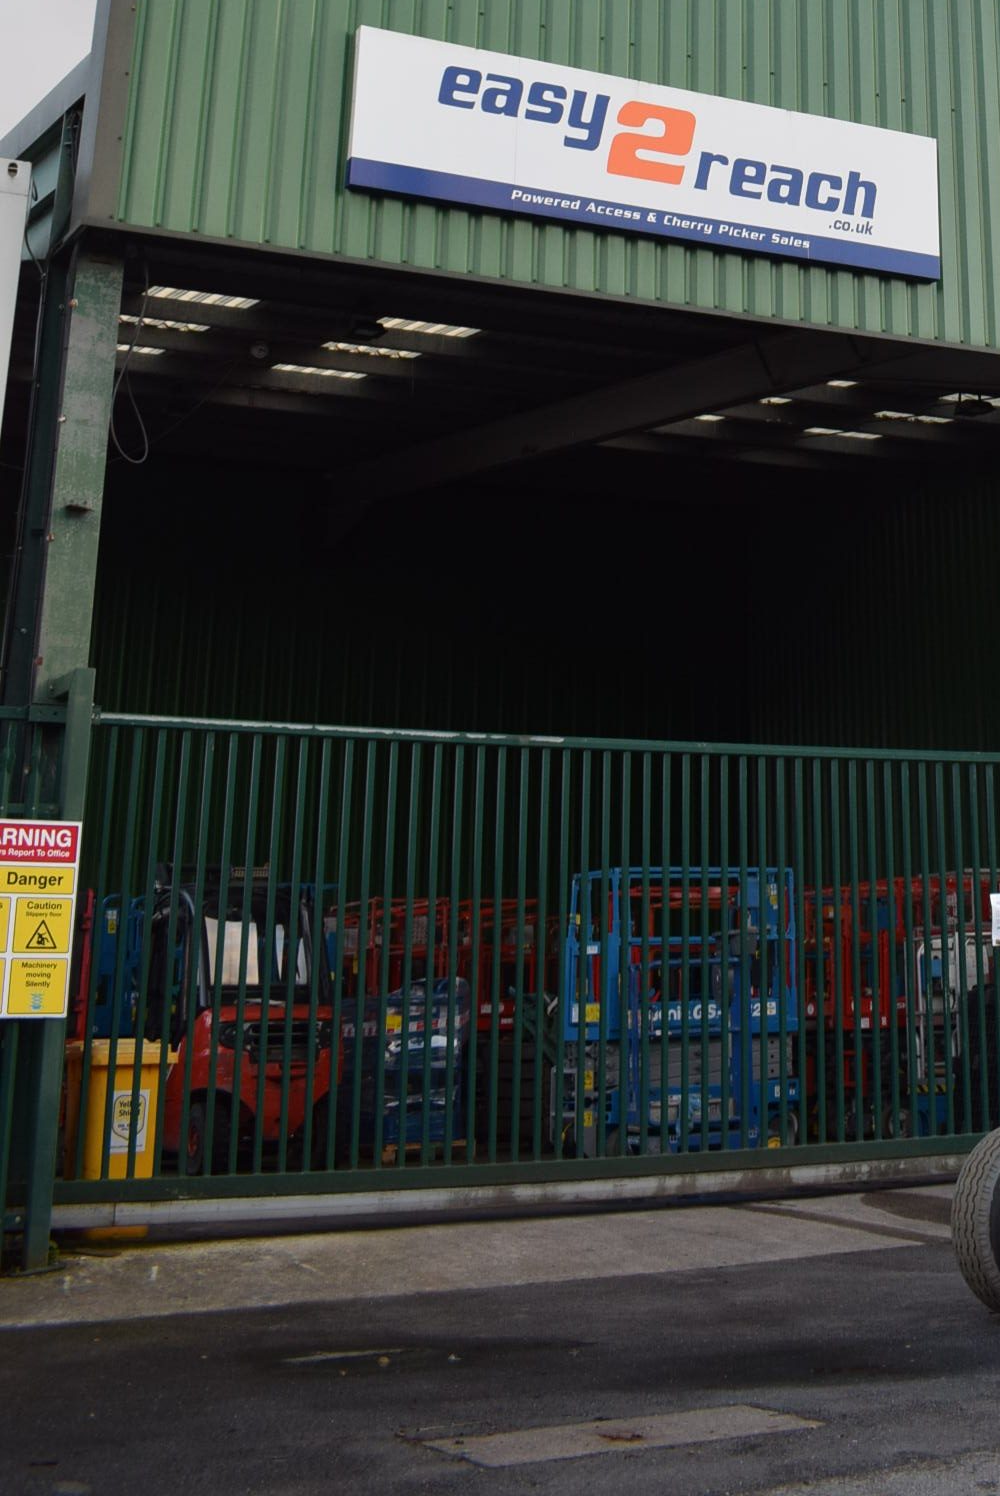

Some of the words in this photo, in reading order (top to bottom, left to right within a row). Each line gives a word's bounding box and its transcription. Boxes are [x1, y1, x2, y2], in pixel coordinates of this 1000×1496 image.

[511, 189, 580, 210] Powered
[585, 202, 641, 221] Access
[647, 213, 657, 224] &
[663, 214, 713, 235] Cherry
[771, 232, 811, 249] Sales
[828, 217, 873, 236] .co.uk
[0, 827, 72, 848] RNING
[8, 848, 35, 857] Report
[36, 849, 46, 857] To
[47, 849, 70, 857] Office
[7, 871, 64, 890] Danger
[27, 901, 62, 910] Caution
[22, 962, 57, 970] Machinery
[25, 980, 50, 988] Silently
